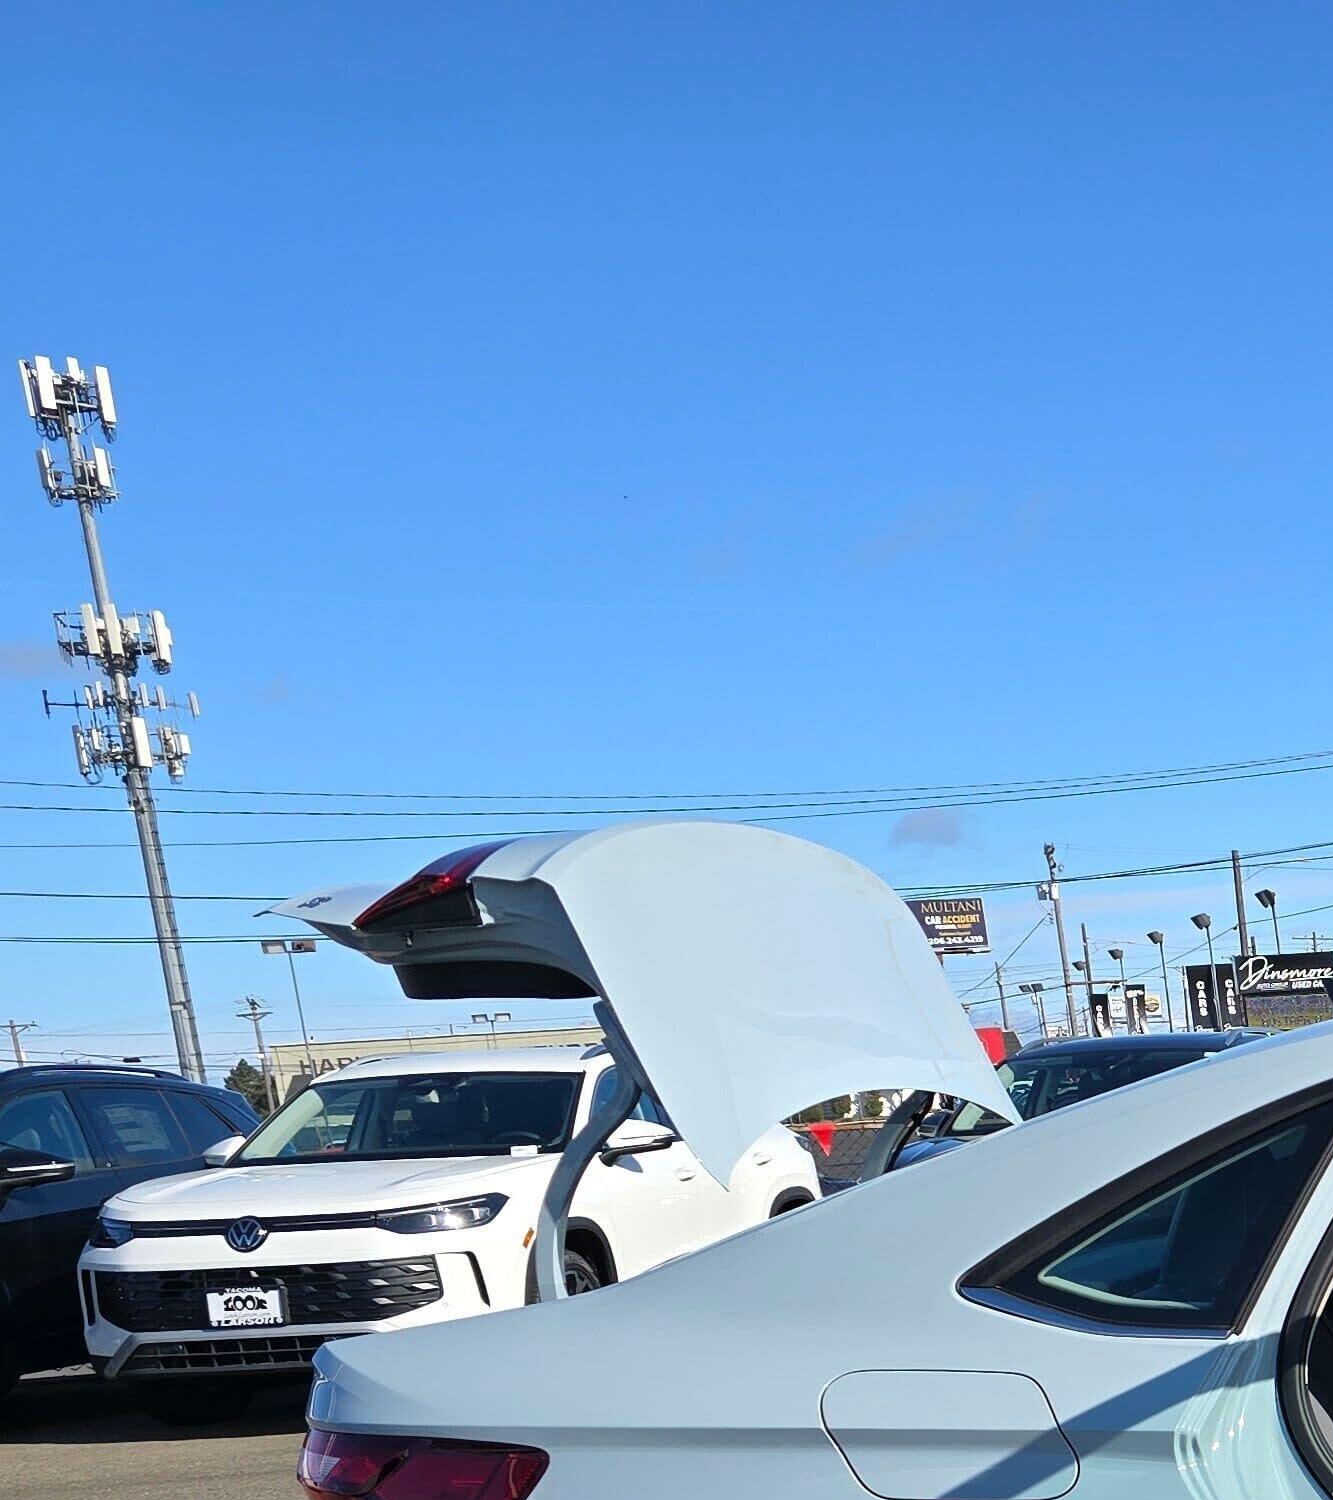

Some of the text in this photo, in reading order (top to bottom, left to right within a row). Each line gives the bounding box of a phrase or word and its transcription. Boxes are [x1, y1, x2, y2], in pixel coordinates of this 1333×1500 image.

[921, 900, 981, 913] MULTANI
[925, 914, 980, 925] CAR ACCIDENT
[1292, 981, 1312, 989] USED
[1195, 980, 1208, 1016] CARS
[1224, 978, 1237, 1015] CARS
[220, 1317, 275, 1327] LARSON
